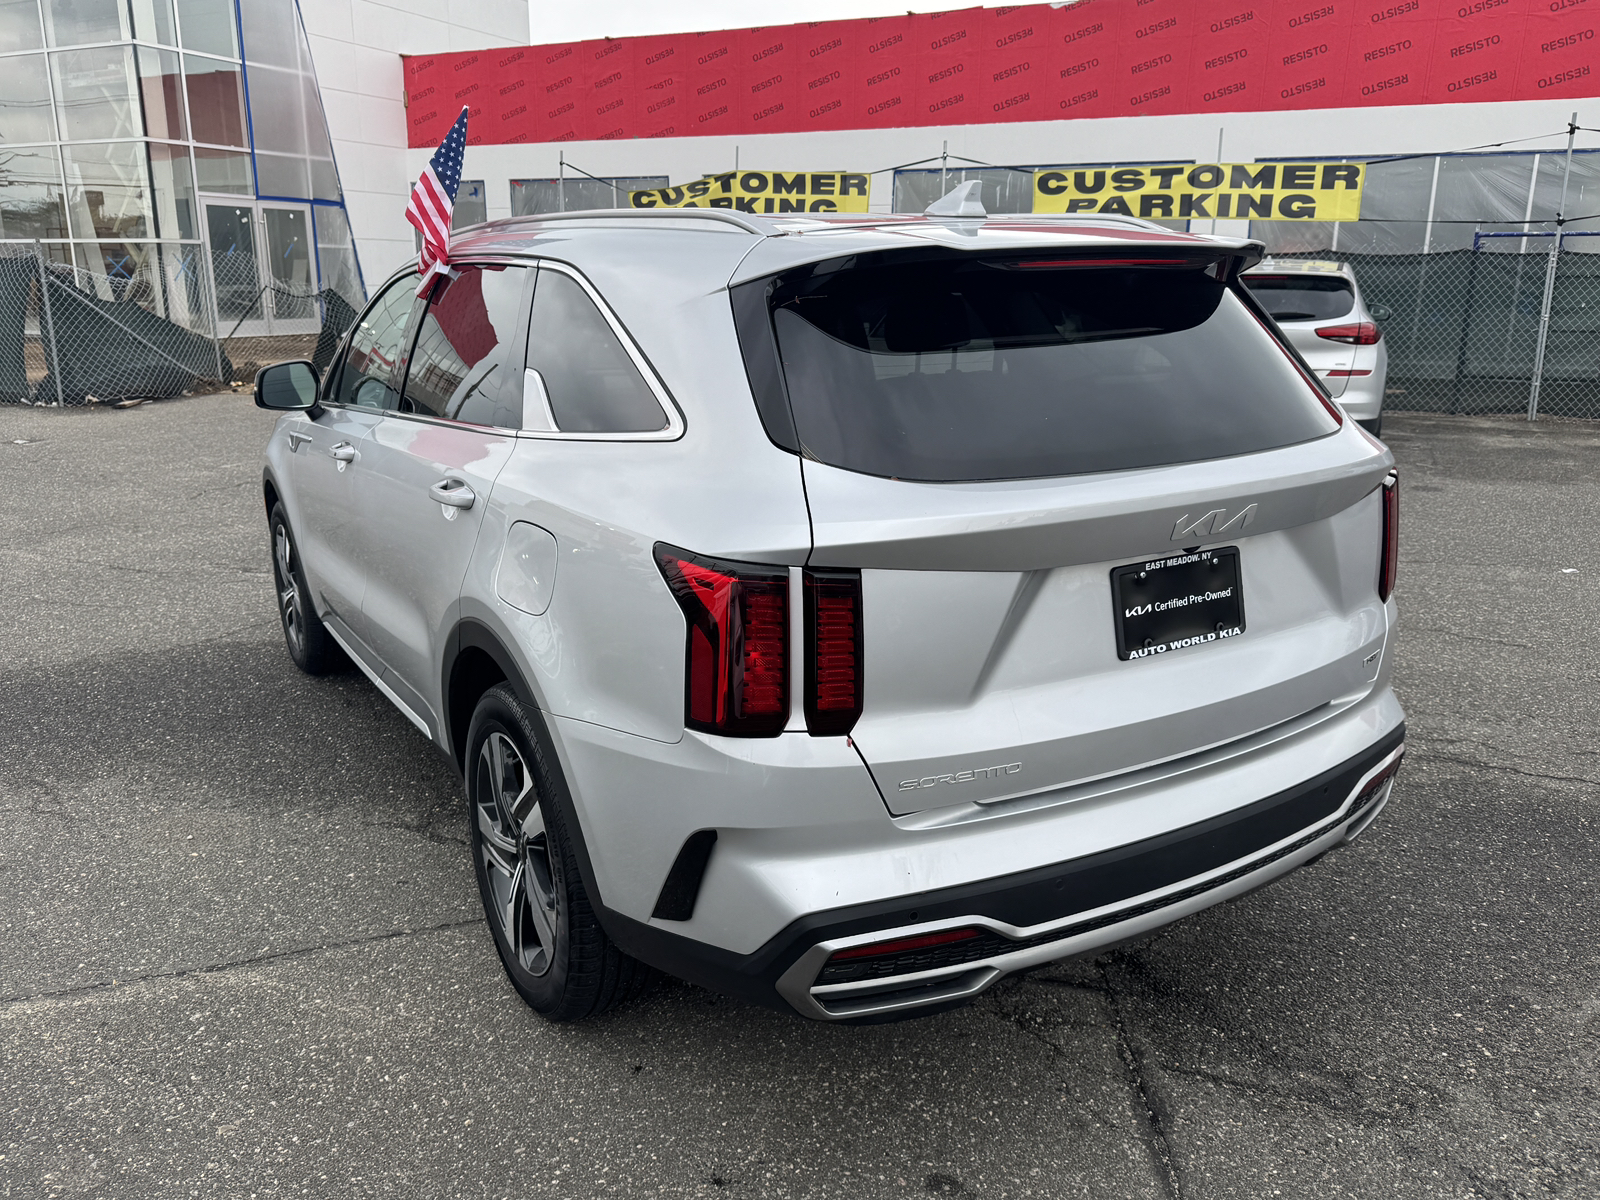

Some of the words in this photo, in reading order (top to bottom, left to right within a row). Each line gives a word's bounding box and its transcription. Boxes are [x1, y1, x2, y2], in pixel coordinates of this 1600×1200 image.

[1210, 10, 1253, 32] RESISTO
[1289, 5, 1334, 28] RESISTO
[1372, 0, 1419, 22] RESISTO
[996, 27, 1033, 48] RESISTO
[1064, 23, 1103, 43] RESISTO
[1136, 17, 1176, 38] RESISTO
[810, 39, 842, 58] RESISTO
[870, 33, 902, 53] RESISTO
[932, 29, 966, 50] RESISTO
[1450, 34, 1500, 58] RESISTO
[1542, 29, 1594, 53] RESISTO
[499, 51, 525, 68] RESISTO
[545, 47, 573, 65] RESISTO
[594, 42, 622, 60] RESISTO
[646, 47, 674, 65] RESISTO
[698, 47, 728, 64] RESISTO
[753, 43, 783, 62] RESISTO
[1205, 48, 1247, 70] RESISTO
[1283, 43, 1328, 66] RESISTO
[1364, 39, 1412, 62] RESISTO
[410, 59, 434, 75] RESISTO
[454, 55, 478, 72] RESISTO
[929, 63, 964, 83] RESISTO
[994, 61, 1030, 82] RESISTO
[1060, 58, 1099, 78] RESISTO
[1132, 53, 1172, 74] RESISTO
[545, 76, 573, 93] RESISTO
[595, 71, 621, 88] RESISTO
[697, 78, 726, 95] RESISTO
[752, 75, 782, 93] RESISTO
[808, 70, 840, 90] RESISTO
[867, 67, 900, 86] RESISTO
[1362, 73, 1408, 96] RESISTO
[1448, 69, 1497, 92] RESISTO
[1538, 65, 1590, 88] RESISTO
[411, 87, 435, 101] RESISTO
[454, 83, 479, 100] RESISTO
[499, 80, 525, 96] RESISTO
[1131, 85, 1170, 106] RESISTO
[1204, 81, 1246, 102] RESISTO
[1281, 77, 1326, 98] RESISTO
[596, 98, 624, 116] RESISTO
[648, 96, 675, 113] RESISTO
[810, 99, 841, 118] RESISTO
[868, 96, 901, 115] RESISTO
[930, 93, 964, 112] RESISTO
[994, 92, 1030, 112] RESISTO
[1060, 89, 1098, 109] RESISTO
[413, 111, 437, 126] RESISTO
[501, 104, 527, 121] RESISTO
[548, 102, 575, 118] RESISTO
[699, 105, 728, 122] RESISTO
[754, 102, 784, 120] RESISTO
[1037, 164, 1360, 195] CUSTOMER
[632, 172, 868, 208] CUSTOMER
[1066, 193, 1317, 218] PARKING
[1170, 503, 1258, 541] KIA
[1145, 560, 1165, 571] EAST
[1201, 551, 1212, 560] NY
[1125, 603, 1152, 618] KIA
[1154, 596, 1188, 612] Certified
[1129, 644, 1167, 660] AUTO
[1169, 632, 1216, 650] WORLD
[1219, 627, 1241, 639] KIA
[898, 761, 1023, 791] SORENTO
